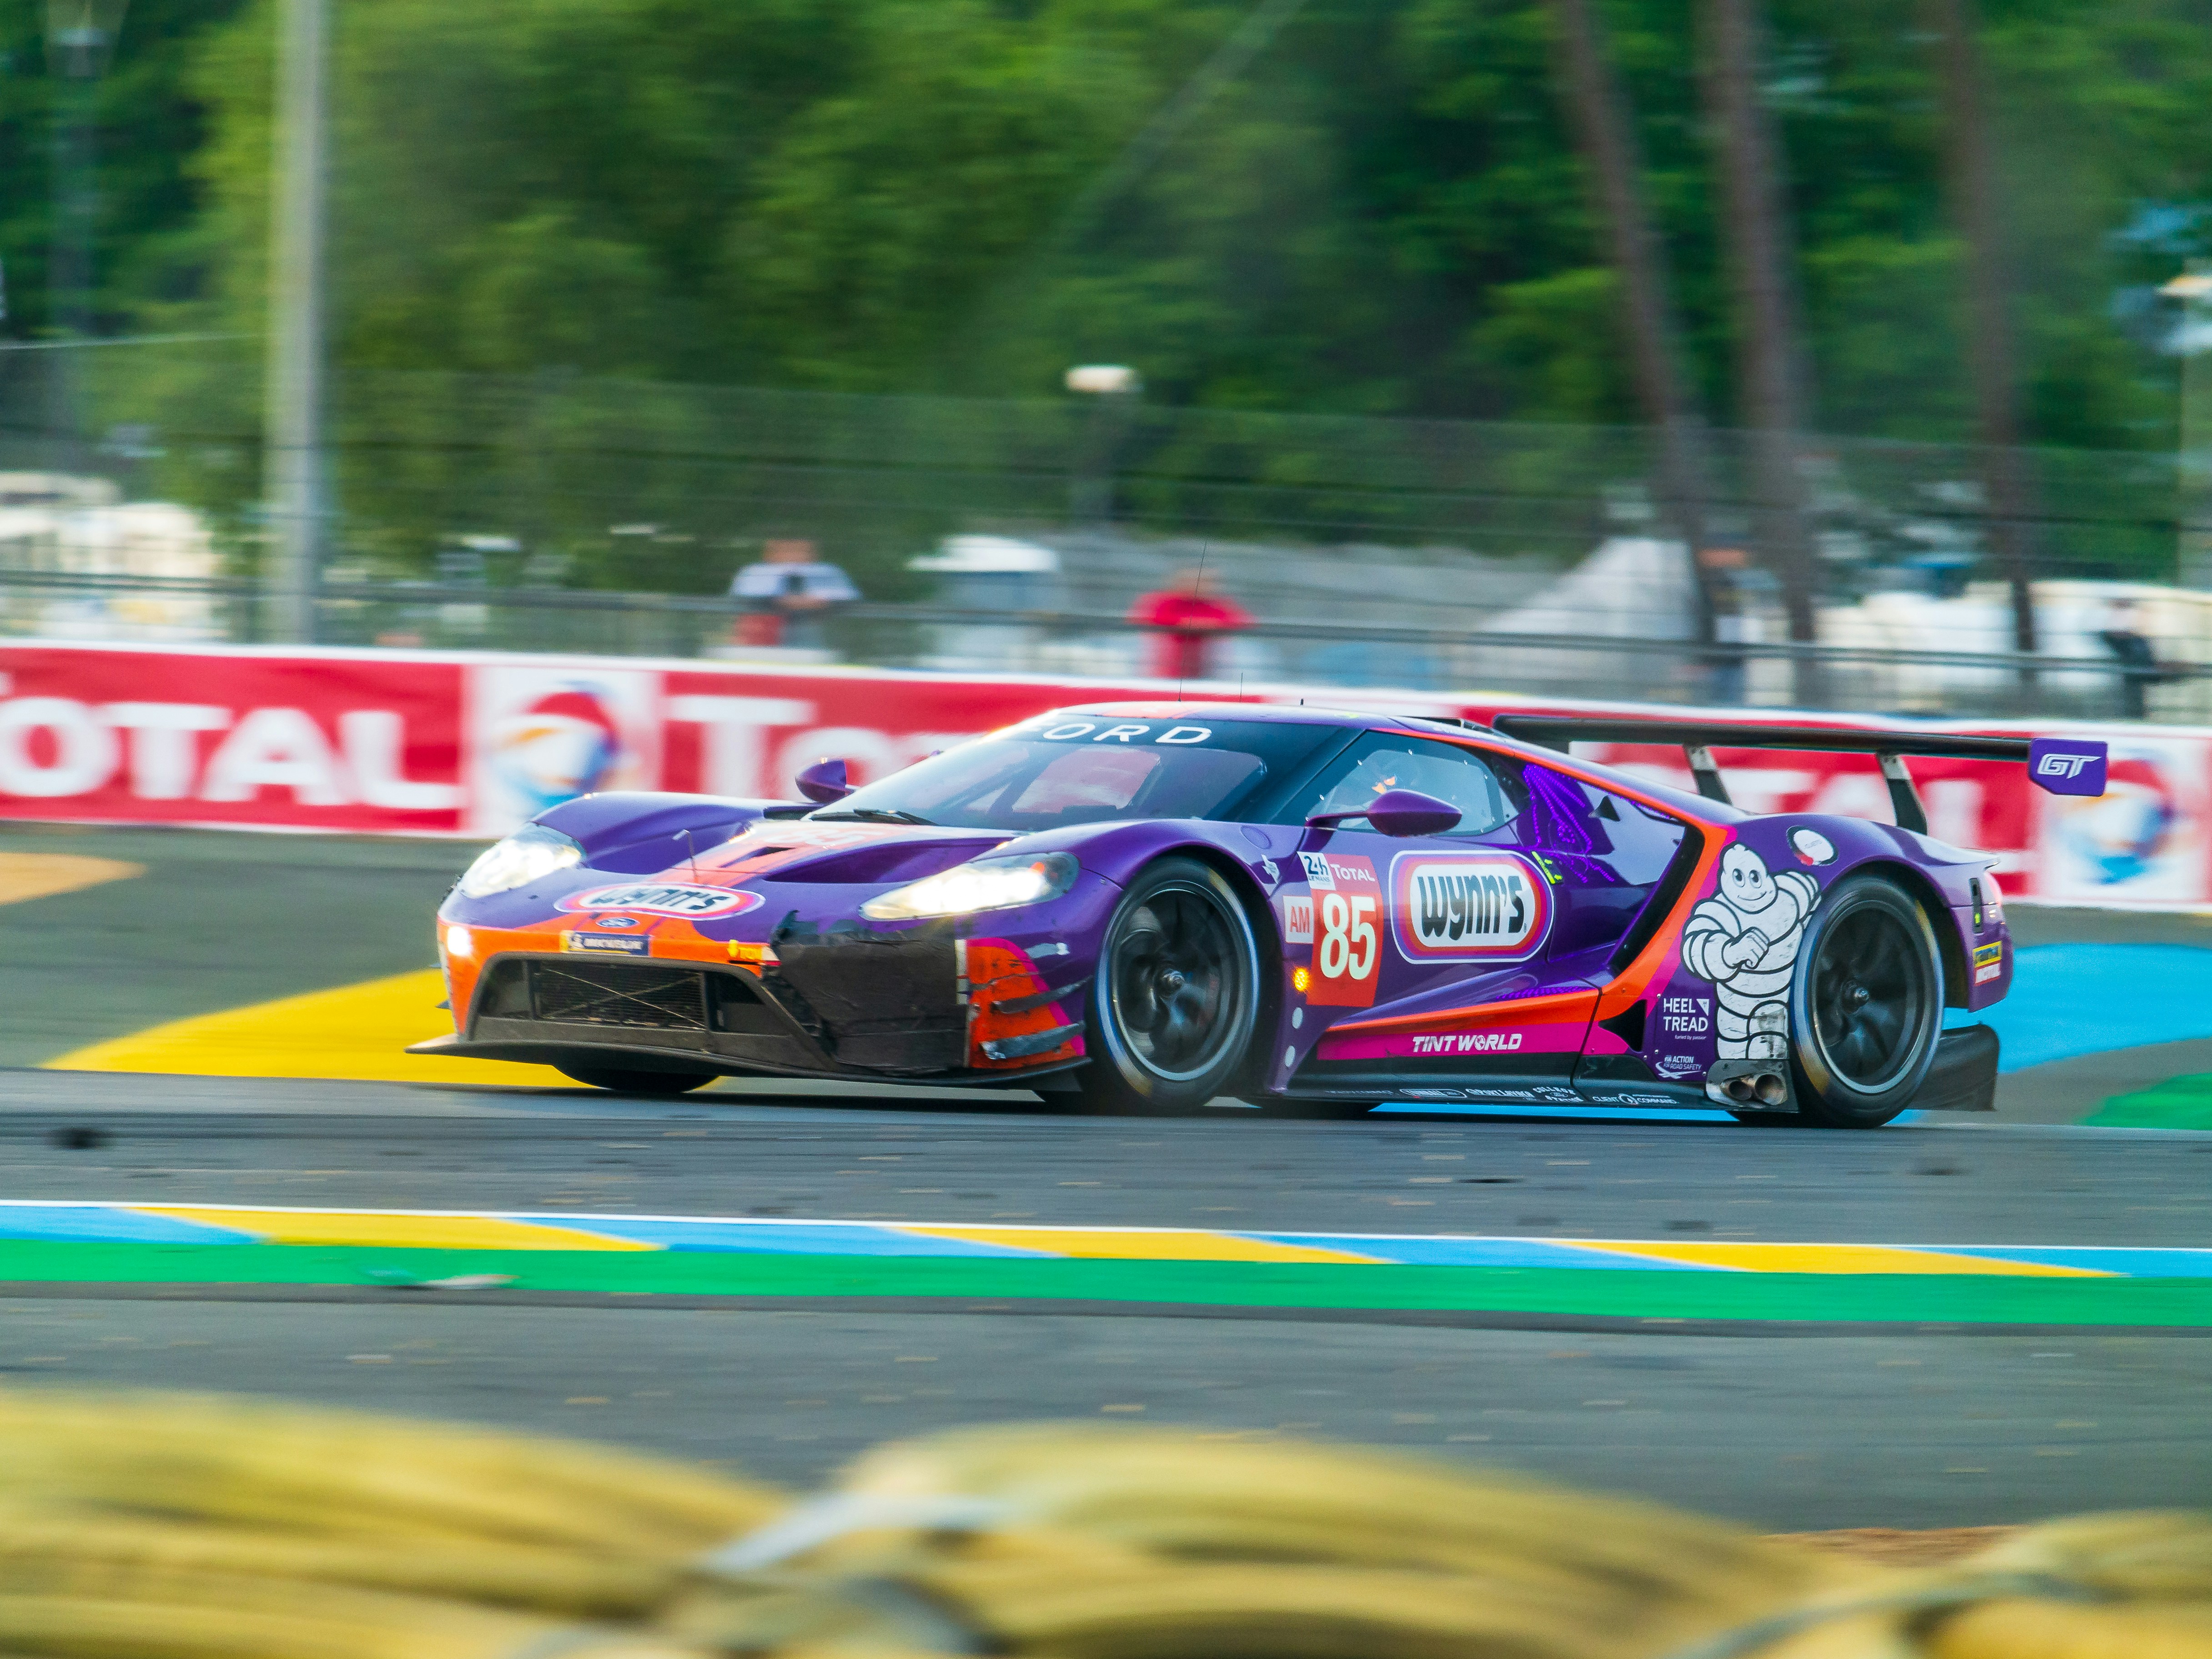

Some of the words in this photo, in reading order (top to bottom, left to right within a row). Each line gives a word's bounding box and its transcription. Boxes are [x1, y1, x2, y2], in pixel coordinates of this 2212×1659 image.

[0, 672, 465, 809] OTAL
[2037, 753, 2102, 779] GT
[1329, 863, 1376, 882] TOTAL
[1289, 905, 1311, 934] AM
[1320, 893, 1376, 980] 85
[1663, 998, 1696, 1013] HEEL
[1663, 1016, 1709, 1032] TREAD
[1413, 1036, 1456, 1053] TINT
[1458, 1033, 1522, 1051] WORLD
